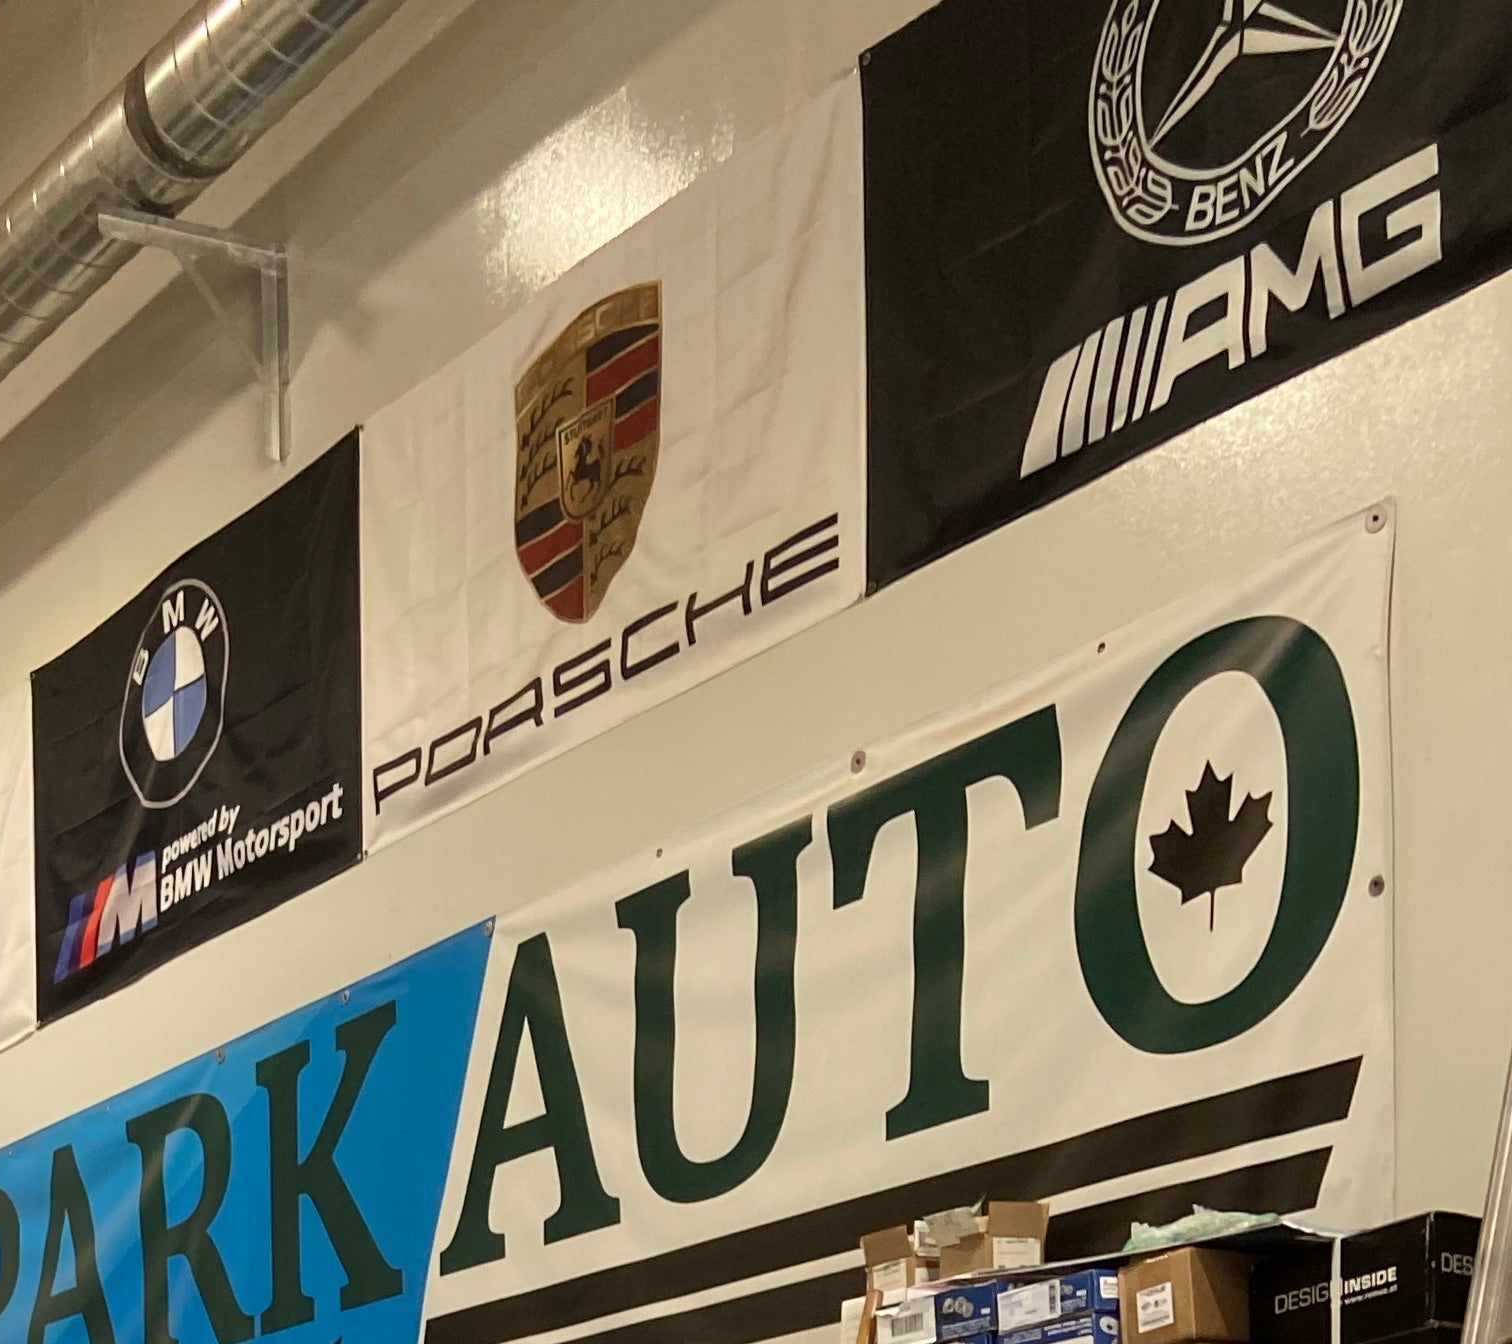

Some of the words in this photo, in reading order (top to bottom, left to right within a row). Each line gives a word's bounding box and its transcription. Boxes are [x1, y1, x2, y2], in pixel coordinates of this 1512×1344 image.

[1186, 131, 1294, 231] BENZ
[131, 591, 219, 686] BMW
[372, 513, 840, 816] PORSCHE
[160, 850, 213, 912] BMW
[217, 783, 344, 880] Motorsport
[162, 808, 217, 873] powered
[218, 804, 240, 835] by
[440, 615, 1360, 1276] AUTO
[1275, 1277, 1343, 1314] DESIG
[1344, 1266, 1397, 1294] INSIDE
